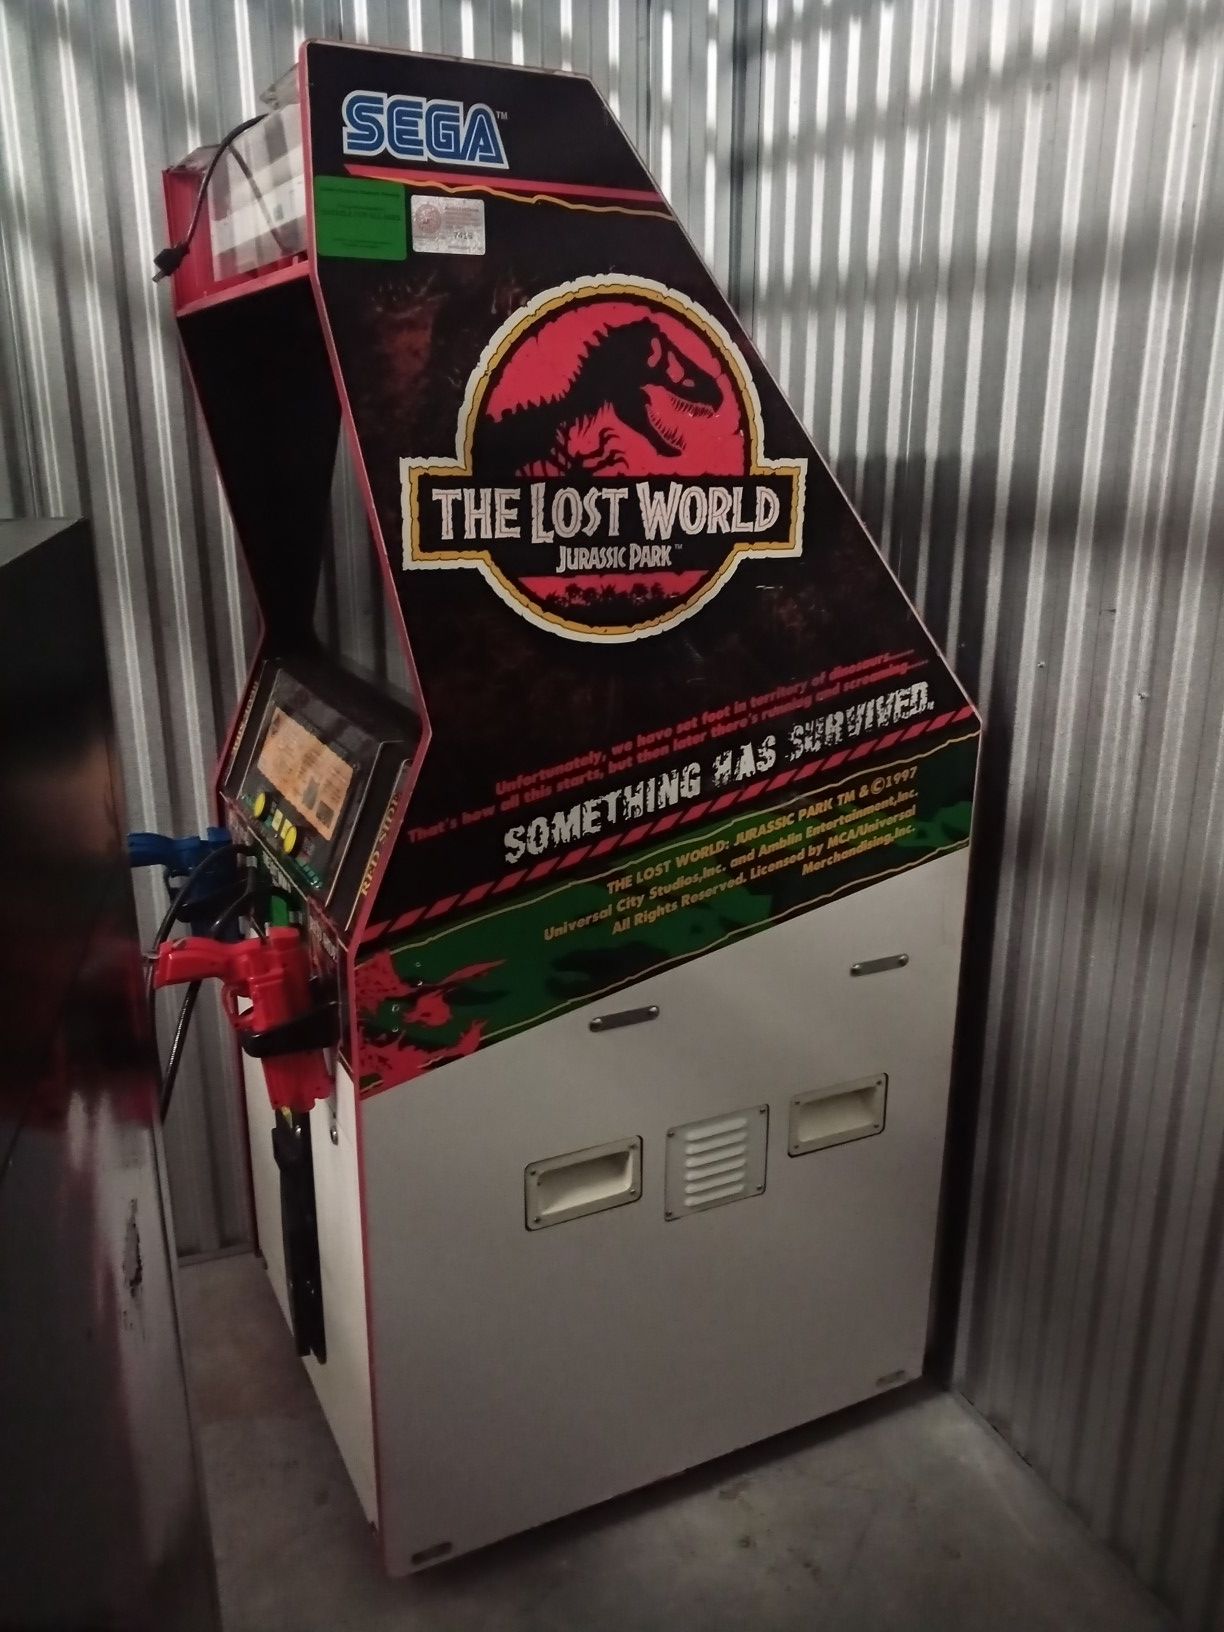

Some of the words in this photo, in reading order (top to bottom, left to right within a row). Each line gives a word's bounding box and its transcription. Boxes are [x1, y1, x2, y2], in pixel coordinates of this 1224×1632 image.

[342, 89, 510, 170] SEGA
[432, 487, 521, 540] THE
[530, 481, 629, 544] LOST
[635, 481, 781, 540] WORLD
[556, 545, 627, 573] JURASSIC
[629, 543, 673, 570] PARK
[408, 817, 458, 843] That's
[462, 805, 496, 825] how
[524, 784, 552, 803] this
[608, 756, 633, 774] but
[636, 745, 670, 763] then
[673, 732, 708, 751] later
[711, 713, 758, 737] there's
[761, 695, 812, 720] running
[815, 682, 840, 701] and
[496, 751, 606, 795] Unfortunately,
[612, 741, 633, 756] we
[636, 728, 673, 747] have
[702, 706, 731, 725] foot
[733, 701, 748, 714] in
[750, 681, 807, 708] territory
[811, 671, 826, 686] of
[504, 762, 701, 864] SOMETHING
[712, 735, 777, 787] HAS
[784, 681, 935, 762] SURVIVED.
[544, 904, 613, 941] Universal
[616, 893, 645, 913] City
[729, 848, 755, 869] and
[757, 831, 803, 858] Amblin
[607, 874, 633, 895] THE
[636, 859, 671, 884] LOST
[675, 839, 730, 869] WORLD:
[733, 812, 795, 847] JURASSIC
[798, 797, 834, 821] PARK
[837, 789, 856, 807] TM
[858, 784, 870, 799] &
[612, 917, 631, 935] All
[634, 900, 678, 926] Rights
[681, 871, 747, 907] Reserved.
[750, 848, 806, 880] Licensed
[807, 842, 824, 857] by
[827, 804, 917, 850] MCA/Universal
